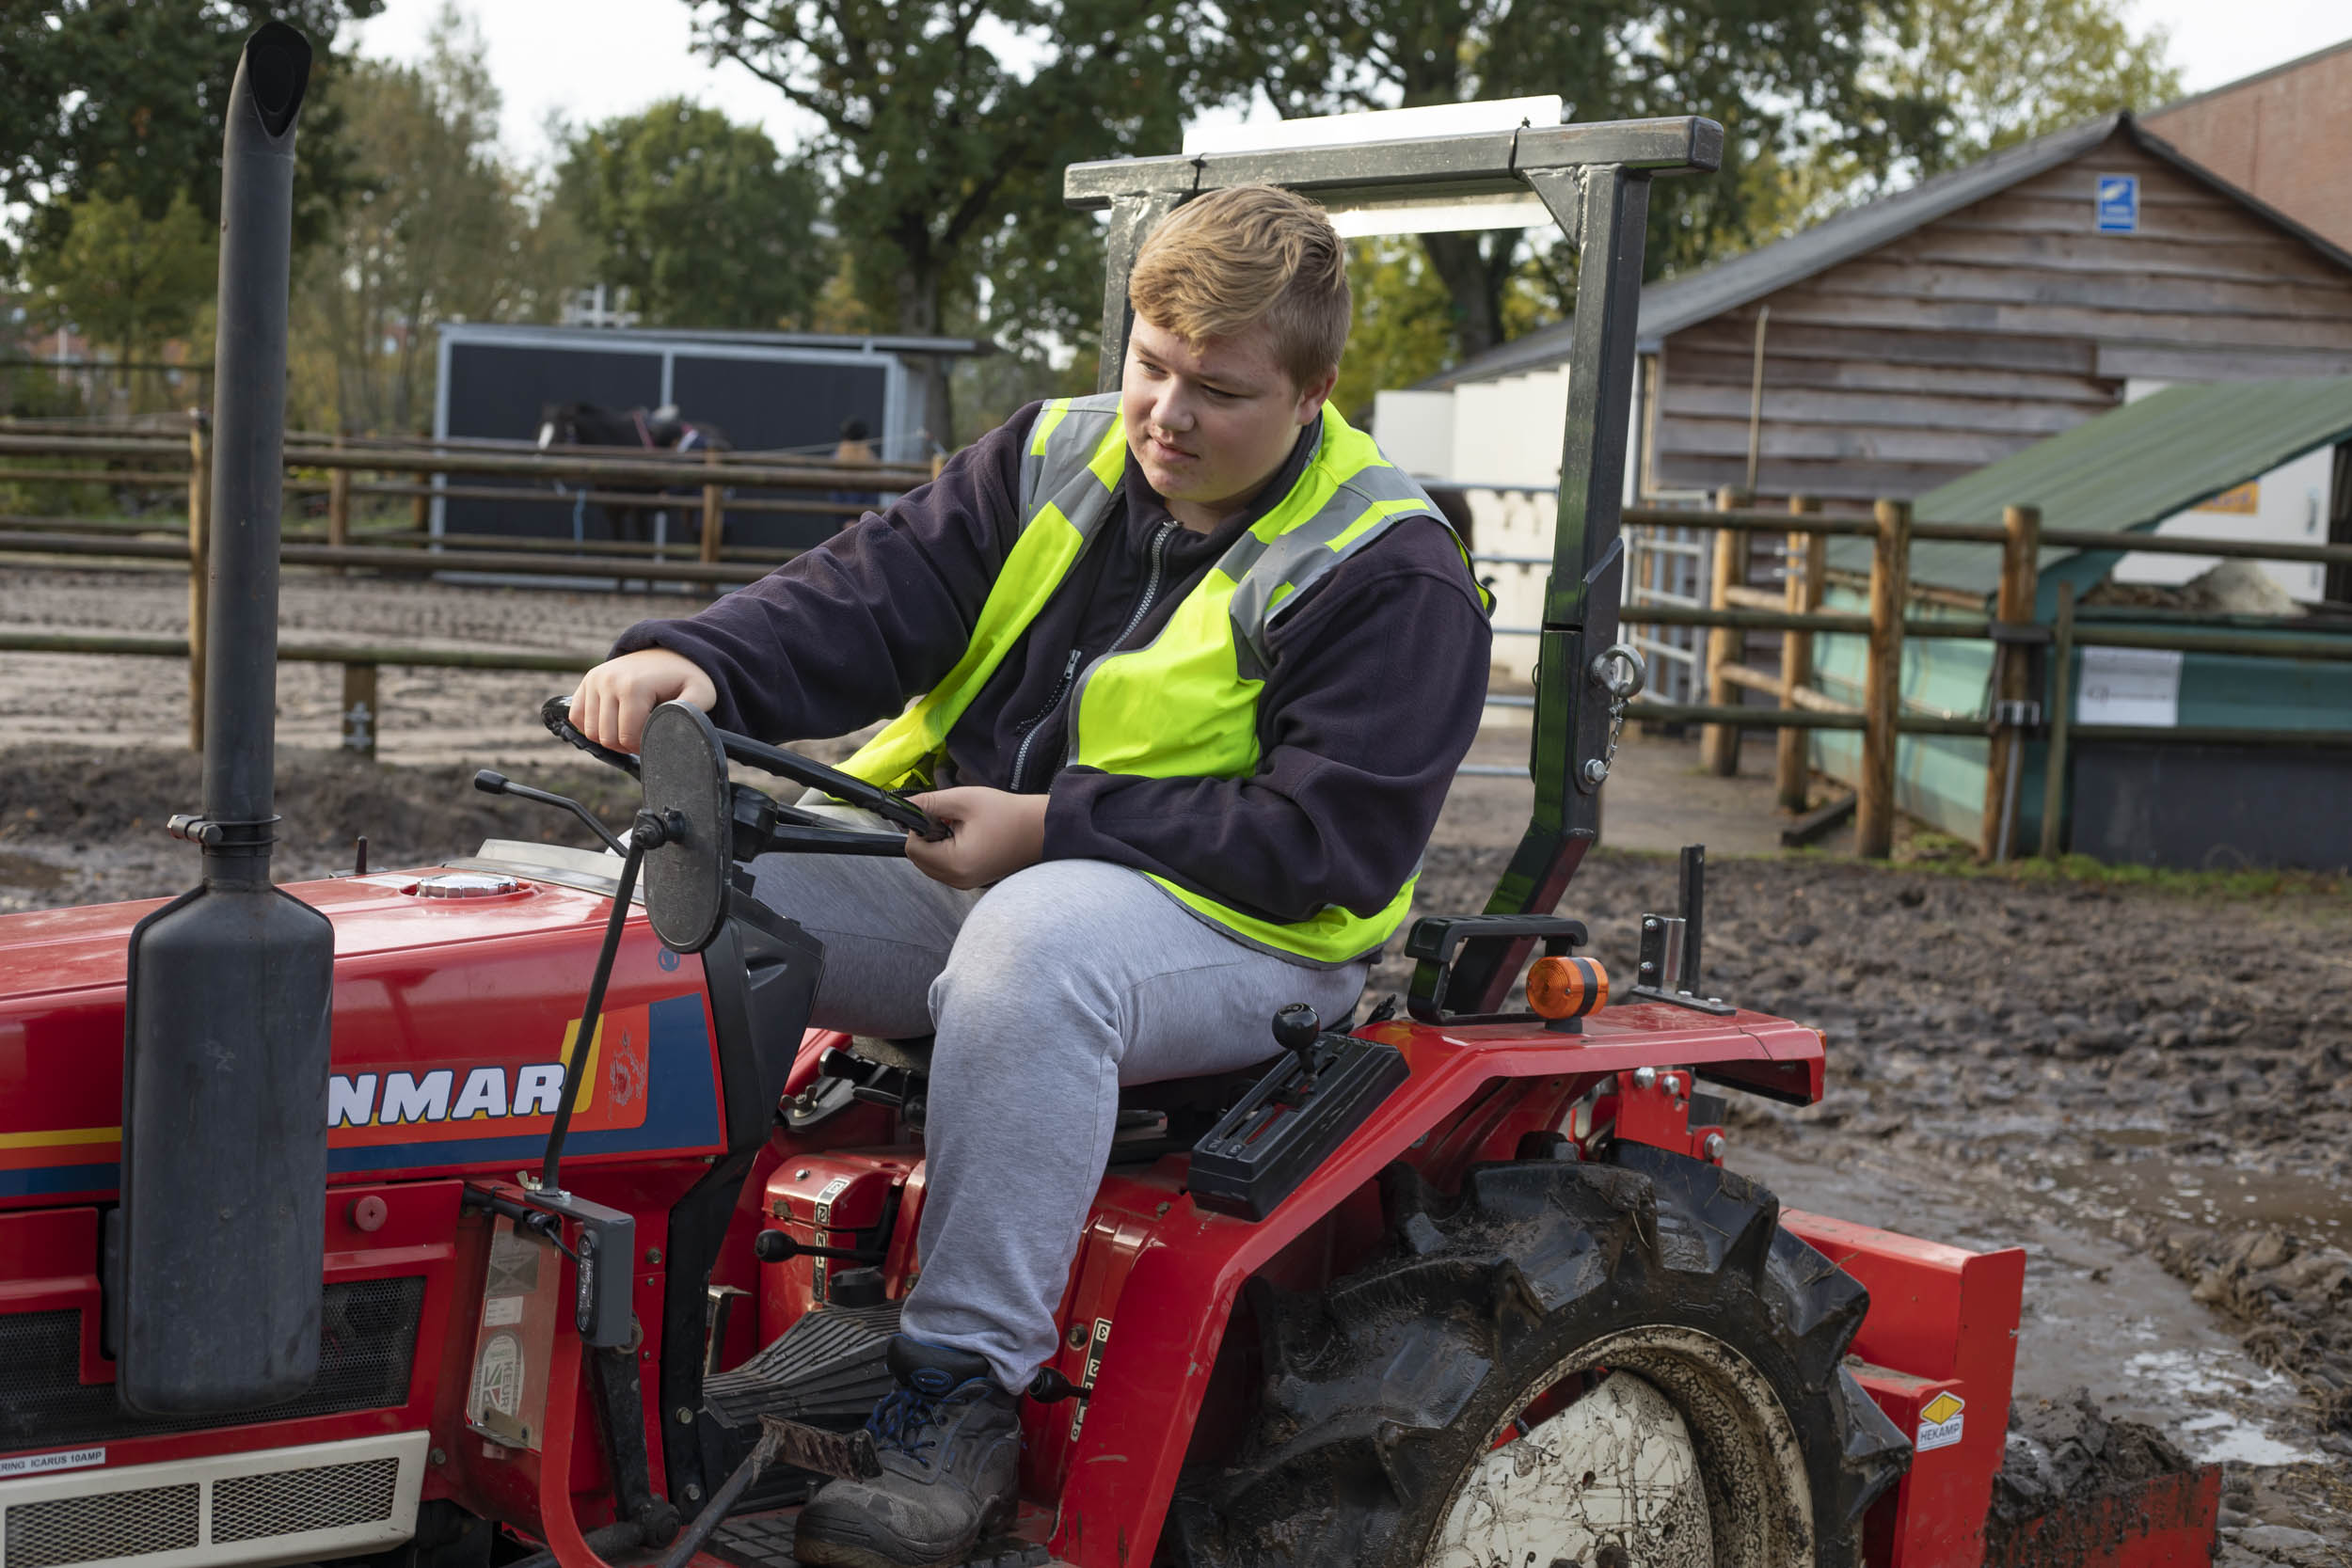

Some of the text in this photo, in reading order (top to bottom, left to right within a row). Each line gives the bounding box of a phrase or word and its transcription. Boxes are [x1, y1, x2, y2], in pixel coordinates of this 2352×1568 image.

[1921, 1423, 1960, 1440] HEKAMP
[31, 1455, 67, 1467] ICARUS
[72, 1451, 102, 1463] 10AMP
